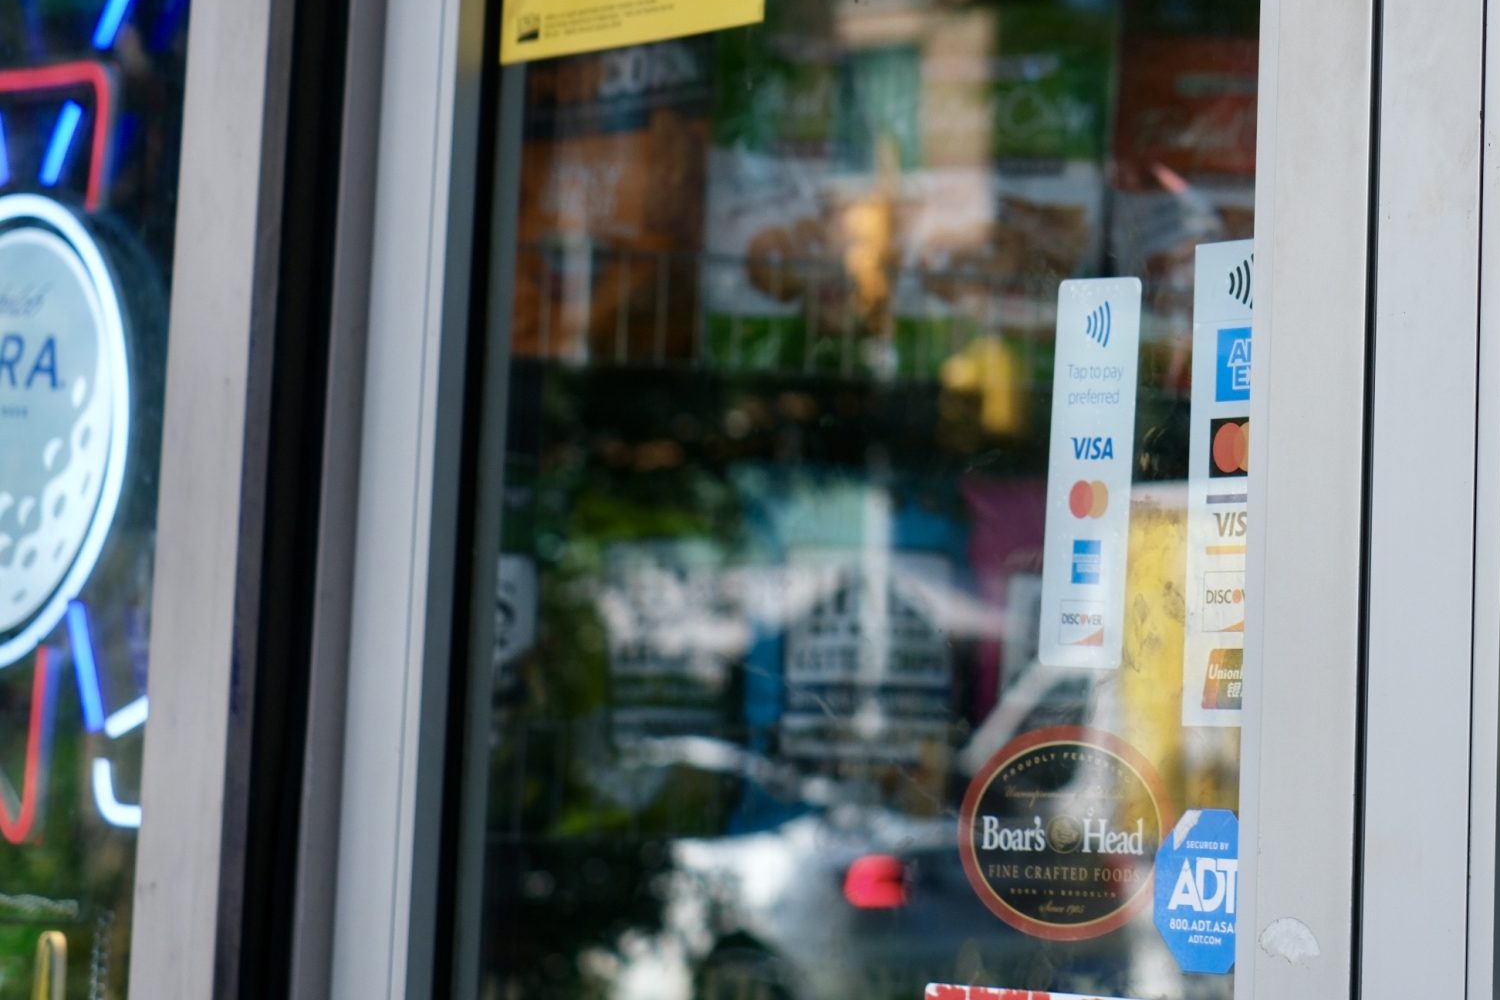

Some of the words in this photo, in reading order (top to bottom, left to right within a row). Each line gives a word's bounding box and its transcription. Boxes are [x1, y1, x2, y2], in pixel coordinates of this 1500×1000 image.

[0, 333, 58, 390] RA
[1068, 364, 1087, 381] Tap
[1089, 365, 1100, 378] to
[1103, 365, 1124, 382] pay
[1232, 365, 1251, 390] E
[1068, 389, 1120, 406] preferred
[1071, 437, 1113, 460] VISA
[1212, 512, 1247, 537] VIS
[1061, 613, 1103, 625] DISCOVER
[1208, 663, 1243, 680] Union
[1003, 753, 1056, 781] PROUDLY
[1063, 752, 1130, 783] FEATURING
[981, 815, 1046, 852] Boar's
[1081, 818, 1144, 855] Head
[1186, 840, 1218, 850] SECURED
[1219, 842, 1229, 850] BY
[988, 864, 1019, 879] FINE
[1024, 865, 1088, 881] CRAFTED
[1093, 868, 1140, 882] FOODS
[1168, 857, 1238, 914] ADT
[1169, 918, 1235, 933] 800.ADT.ASA
[1188, 935, 1222, 945] ADT.COM
